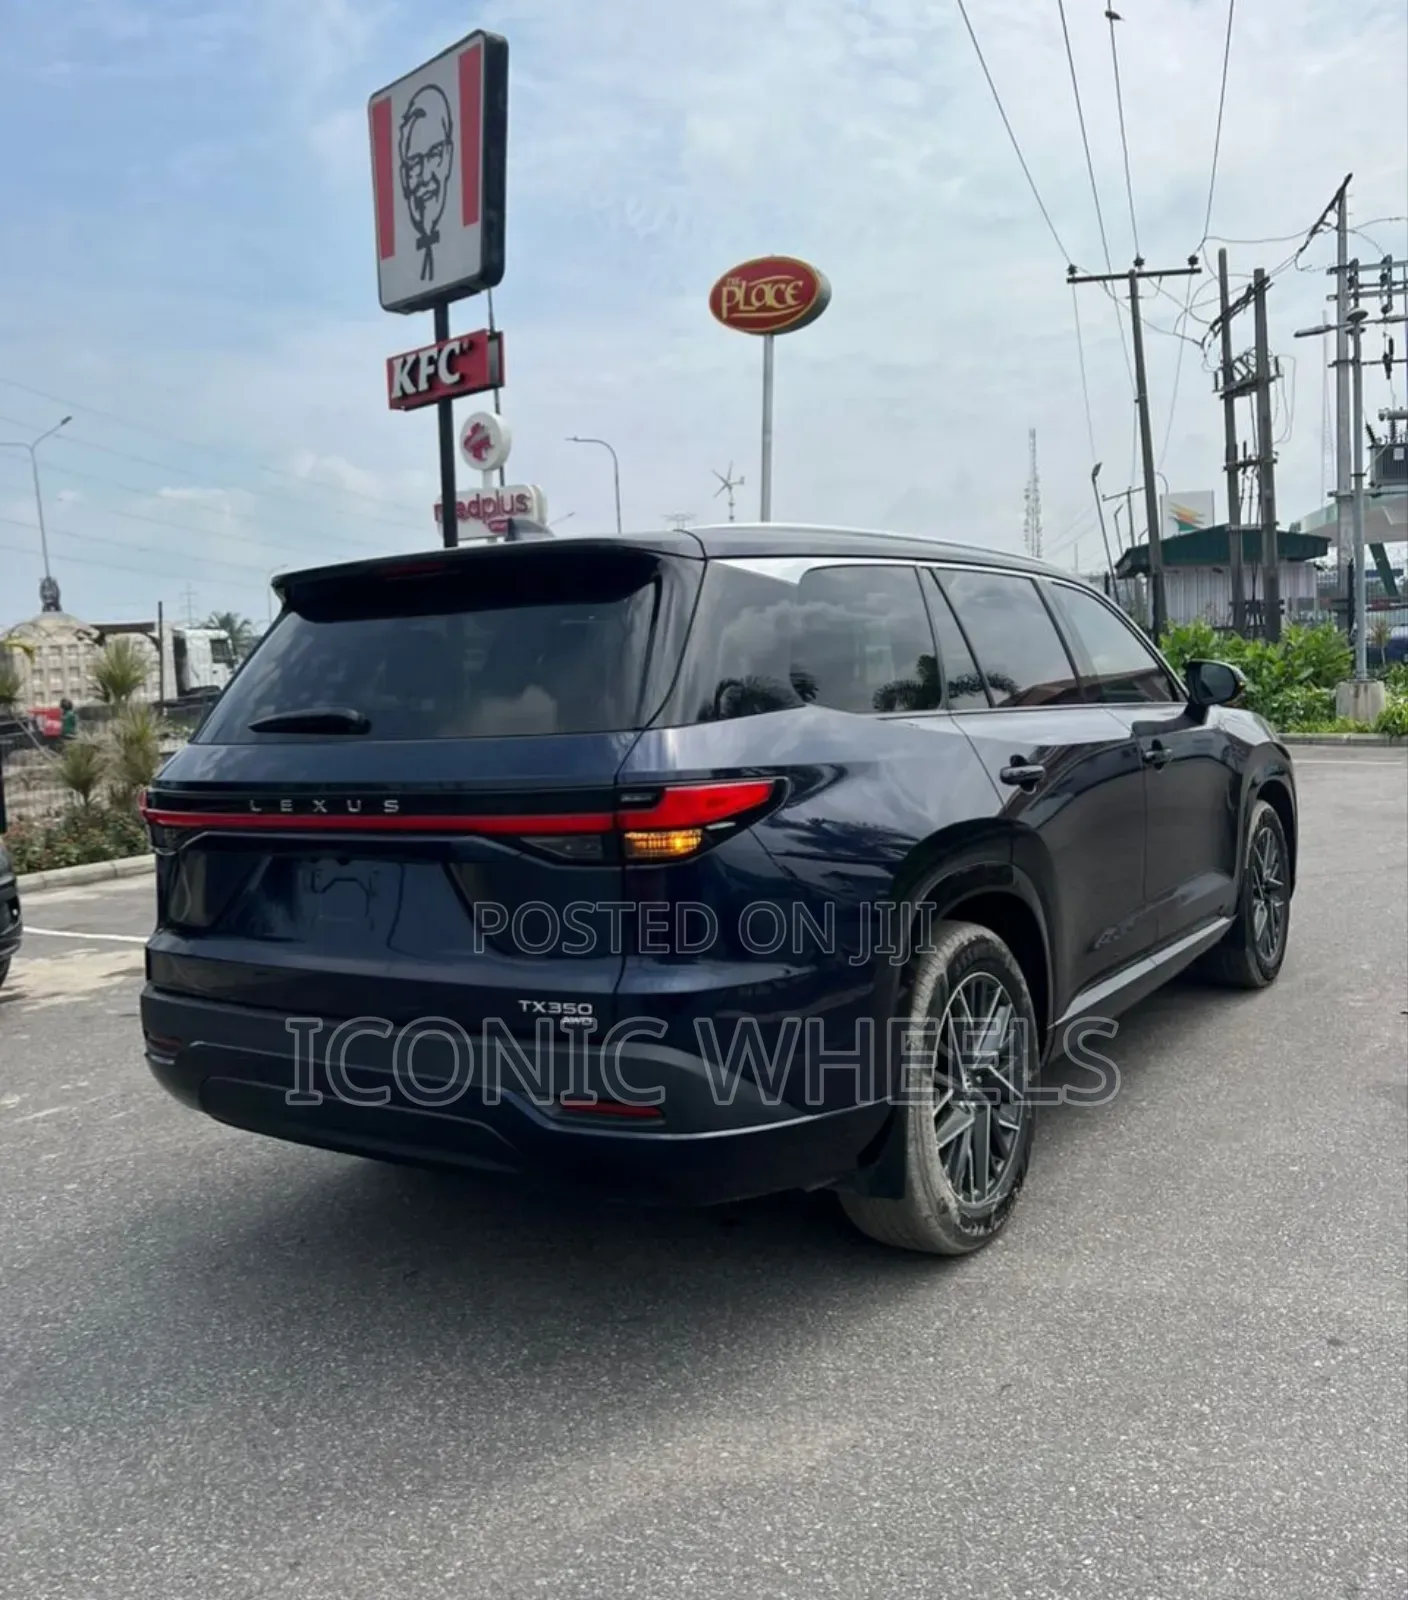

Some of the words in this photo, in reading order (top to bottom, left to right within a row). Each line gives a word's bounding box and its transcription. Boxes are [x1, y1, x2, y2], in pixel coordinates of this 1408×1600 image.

[391, 340, 461, 399] KFC
[249, 799, 400, 813] LEXUS
[518, 999, 593, 1015] TX350
[561, 1016, 593, 1026] AWD
